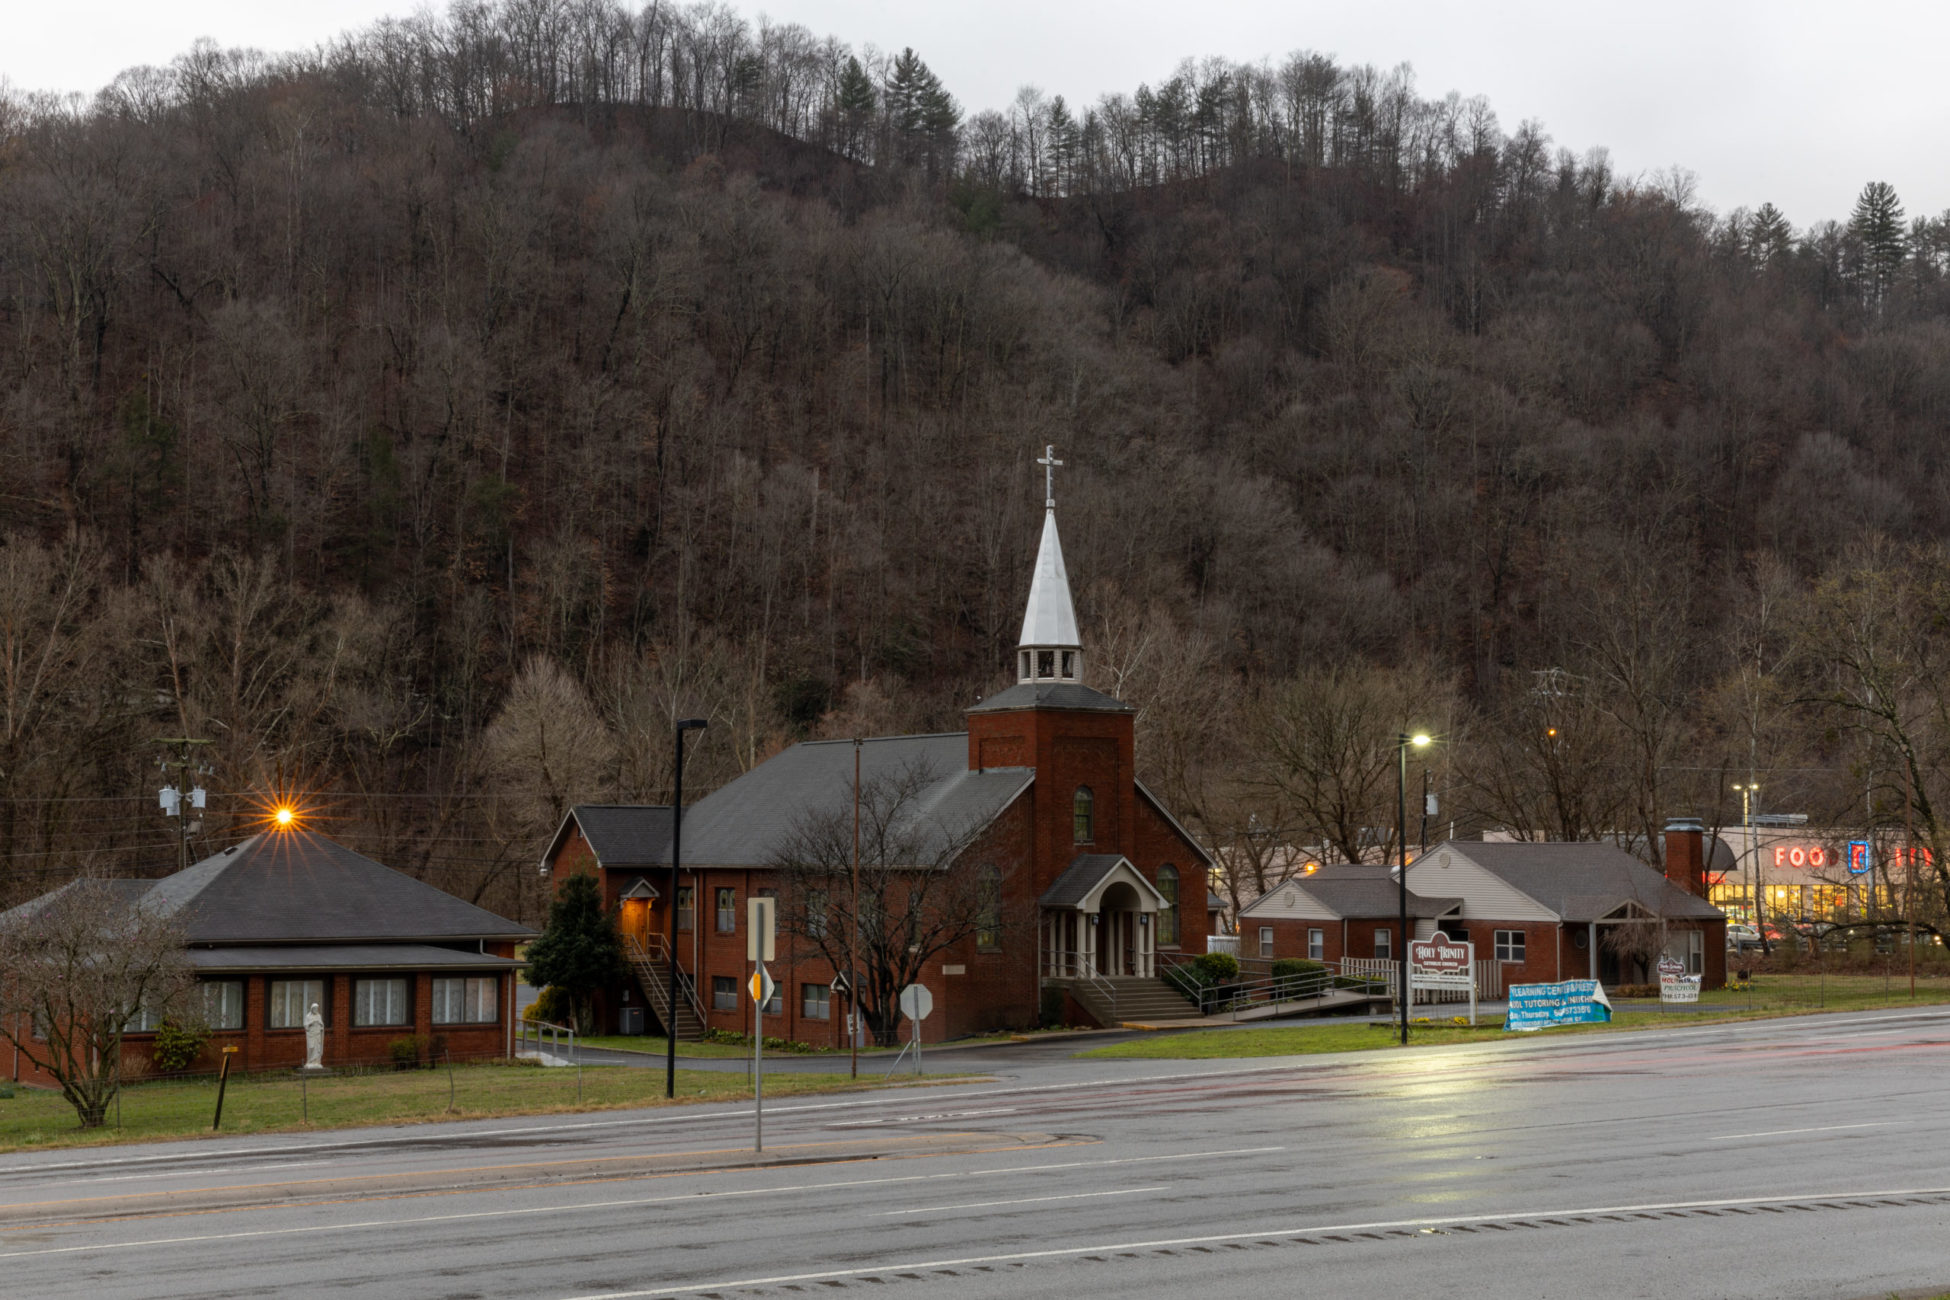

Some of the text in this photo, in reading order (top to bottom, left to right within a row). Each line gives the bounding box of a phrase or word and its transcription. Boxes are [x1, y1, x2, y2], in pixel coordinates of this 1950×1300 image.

[1775, 847, 1838, 867] FOOD
[1416, 946, 1464, 960] HOLY TRINITY
[1547, 985, 1569, 994] CENER
[1524, 999, 1560, 1008] TUTORING
[1521, 1011, 1549, 1020] Thursday
